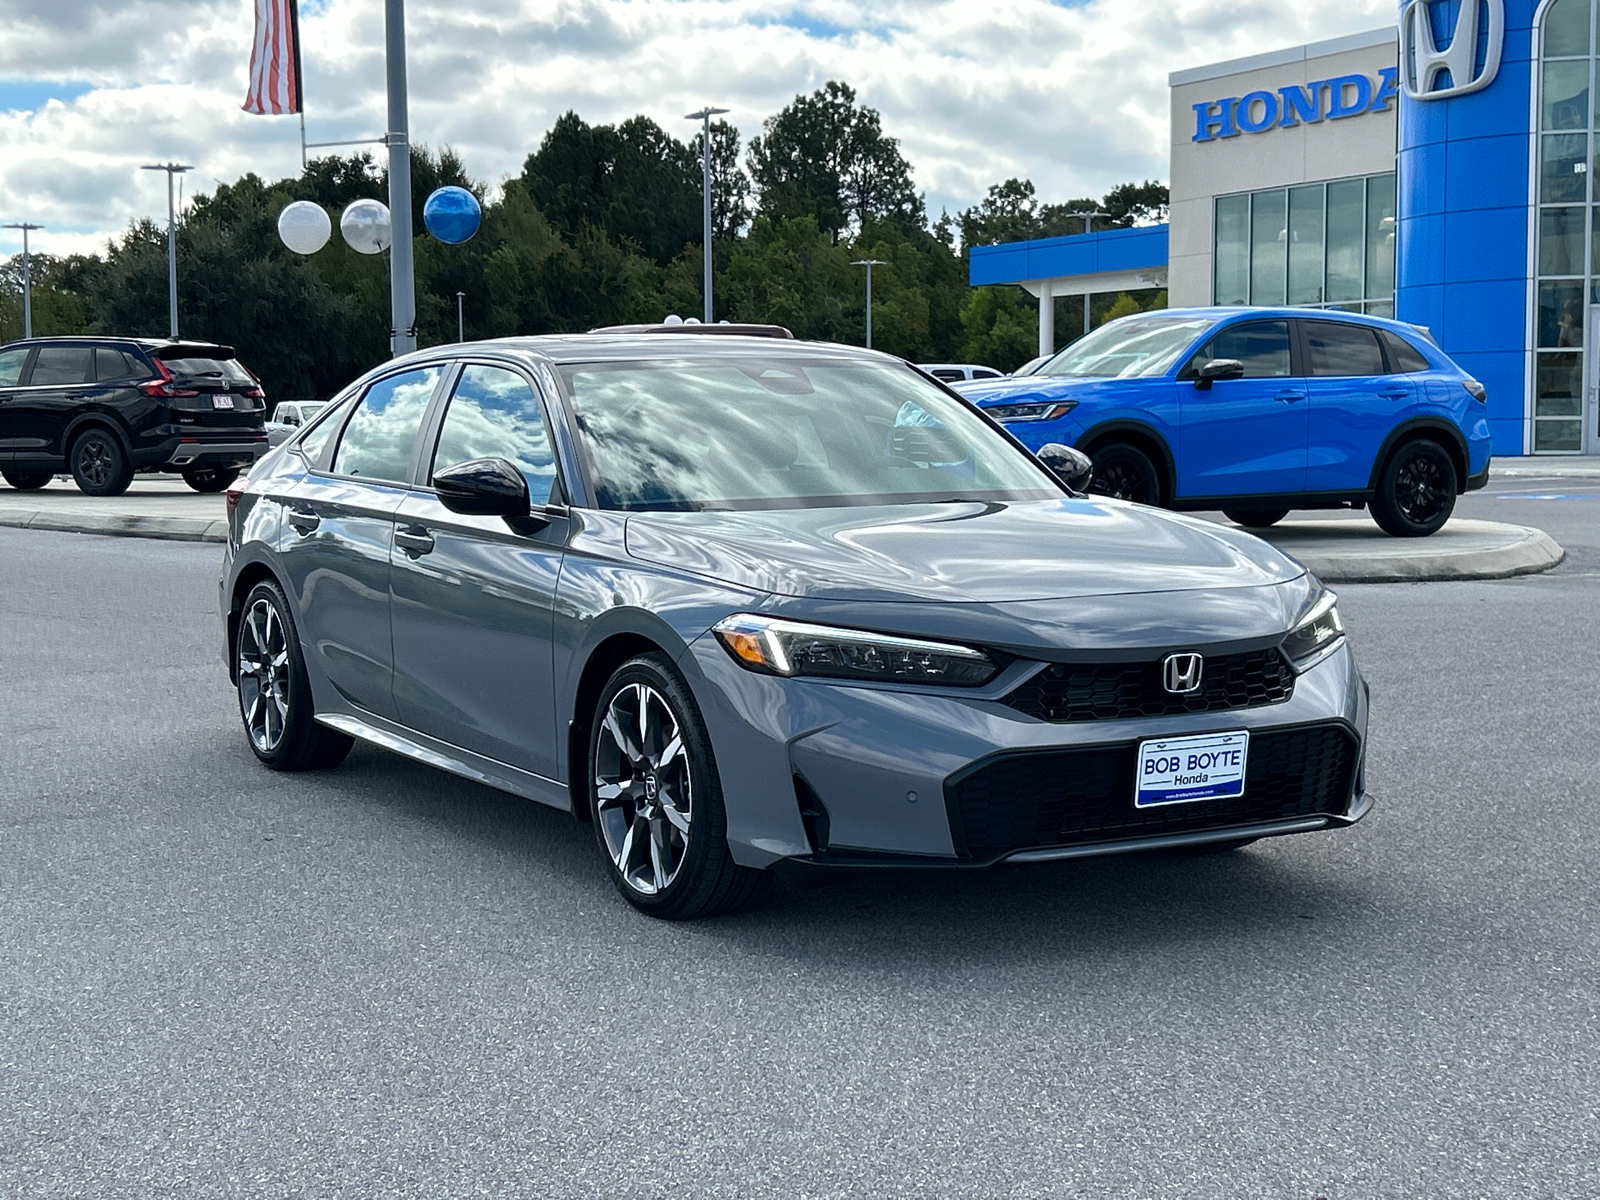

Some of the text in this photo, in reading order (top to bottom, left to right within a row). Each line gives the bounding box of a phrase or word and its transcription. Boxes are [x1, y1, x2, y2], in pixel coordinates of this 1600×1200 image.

[1144, 749, 1242, 775] BOB BOYTE
[1173, 772, 1209, 785] Honda
